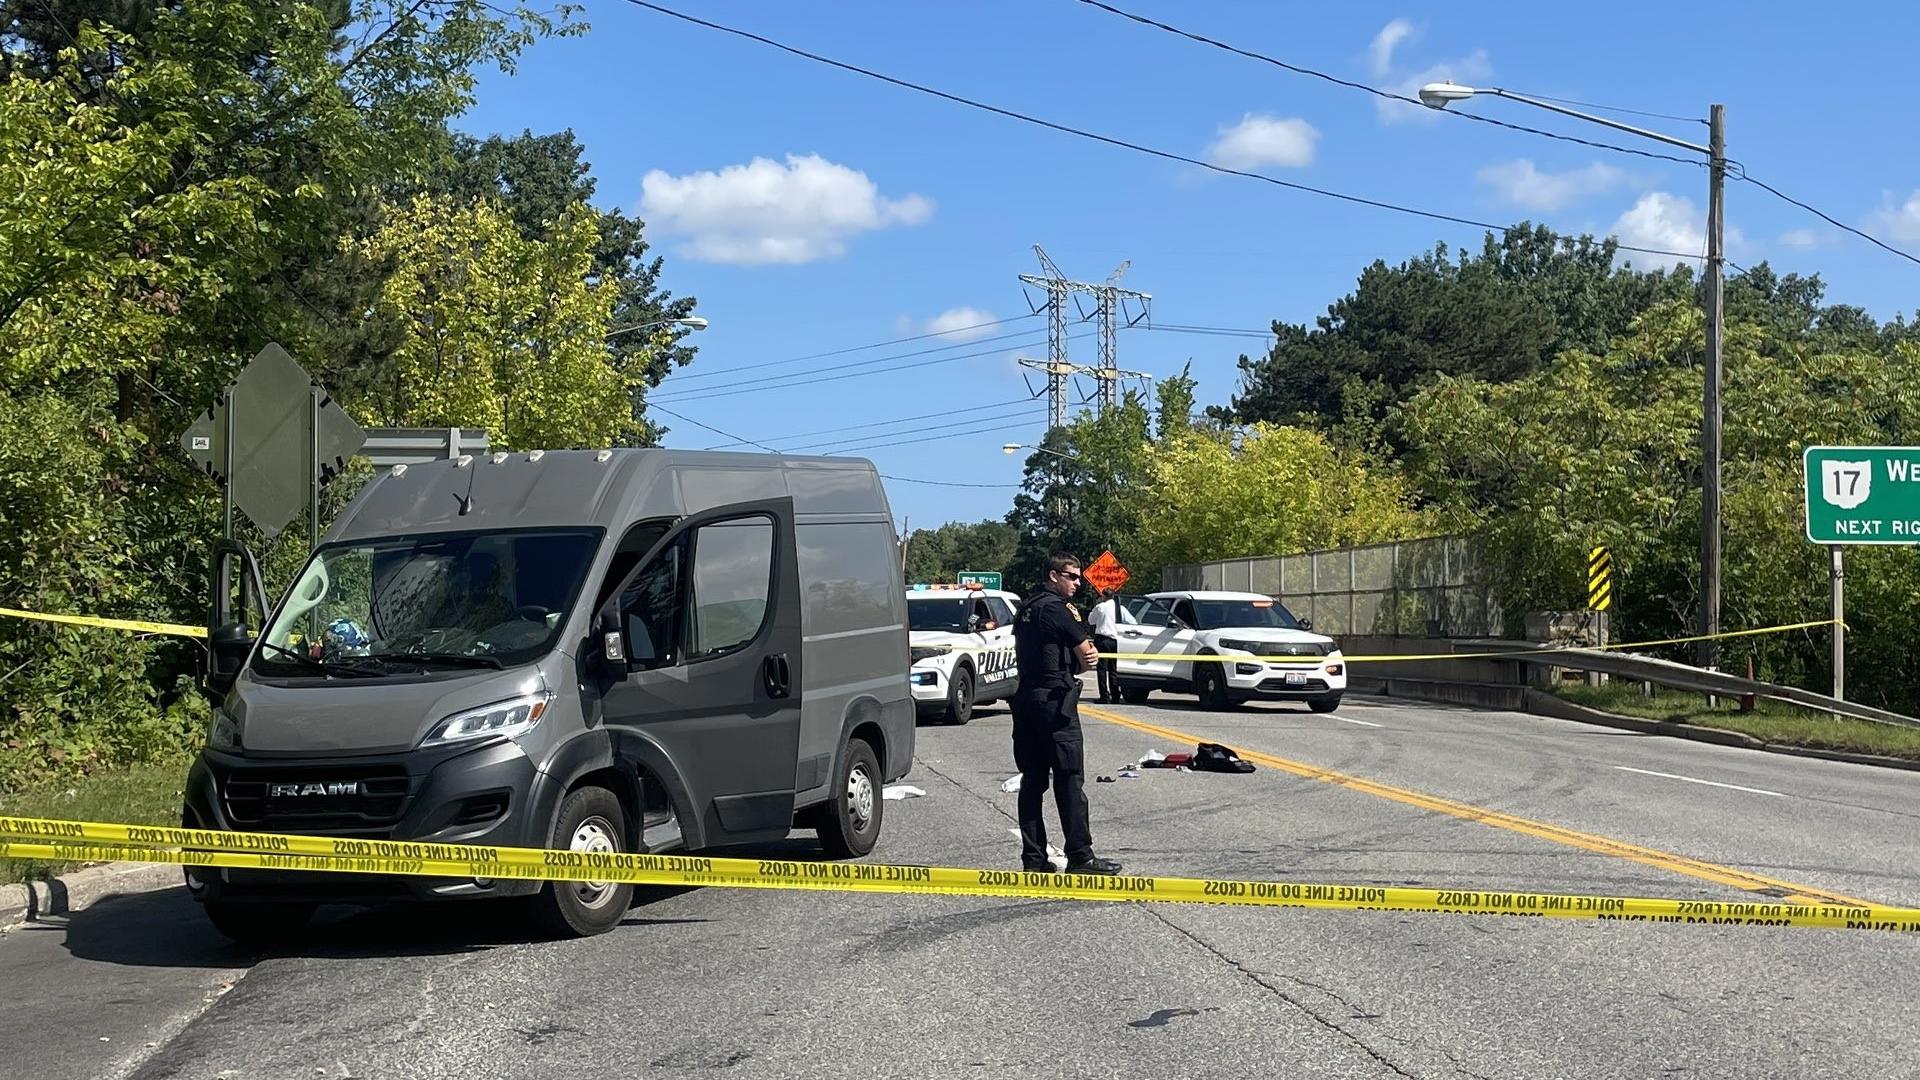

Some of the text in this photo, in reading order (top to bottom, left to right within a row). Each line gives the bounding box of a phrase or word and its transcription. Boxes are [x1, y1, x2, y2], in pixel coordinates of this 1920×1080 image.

[1833, 470, 1860, 495] 17
[1836, 520, 1882, 535] NEXT
[979, 576, 998, 584] WEST
[977, 647, 1017, 675] POLIC
[271, 782, 357, 797] RAM
